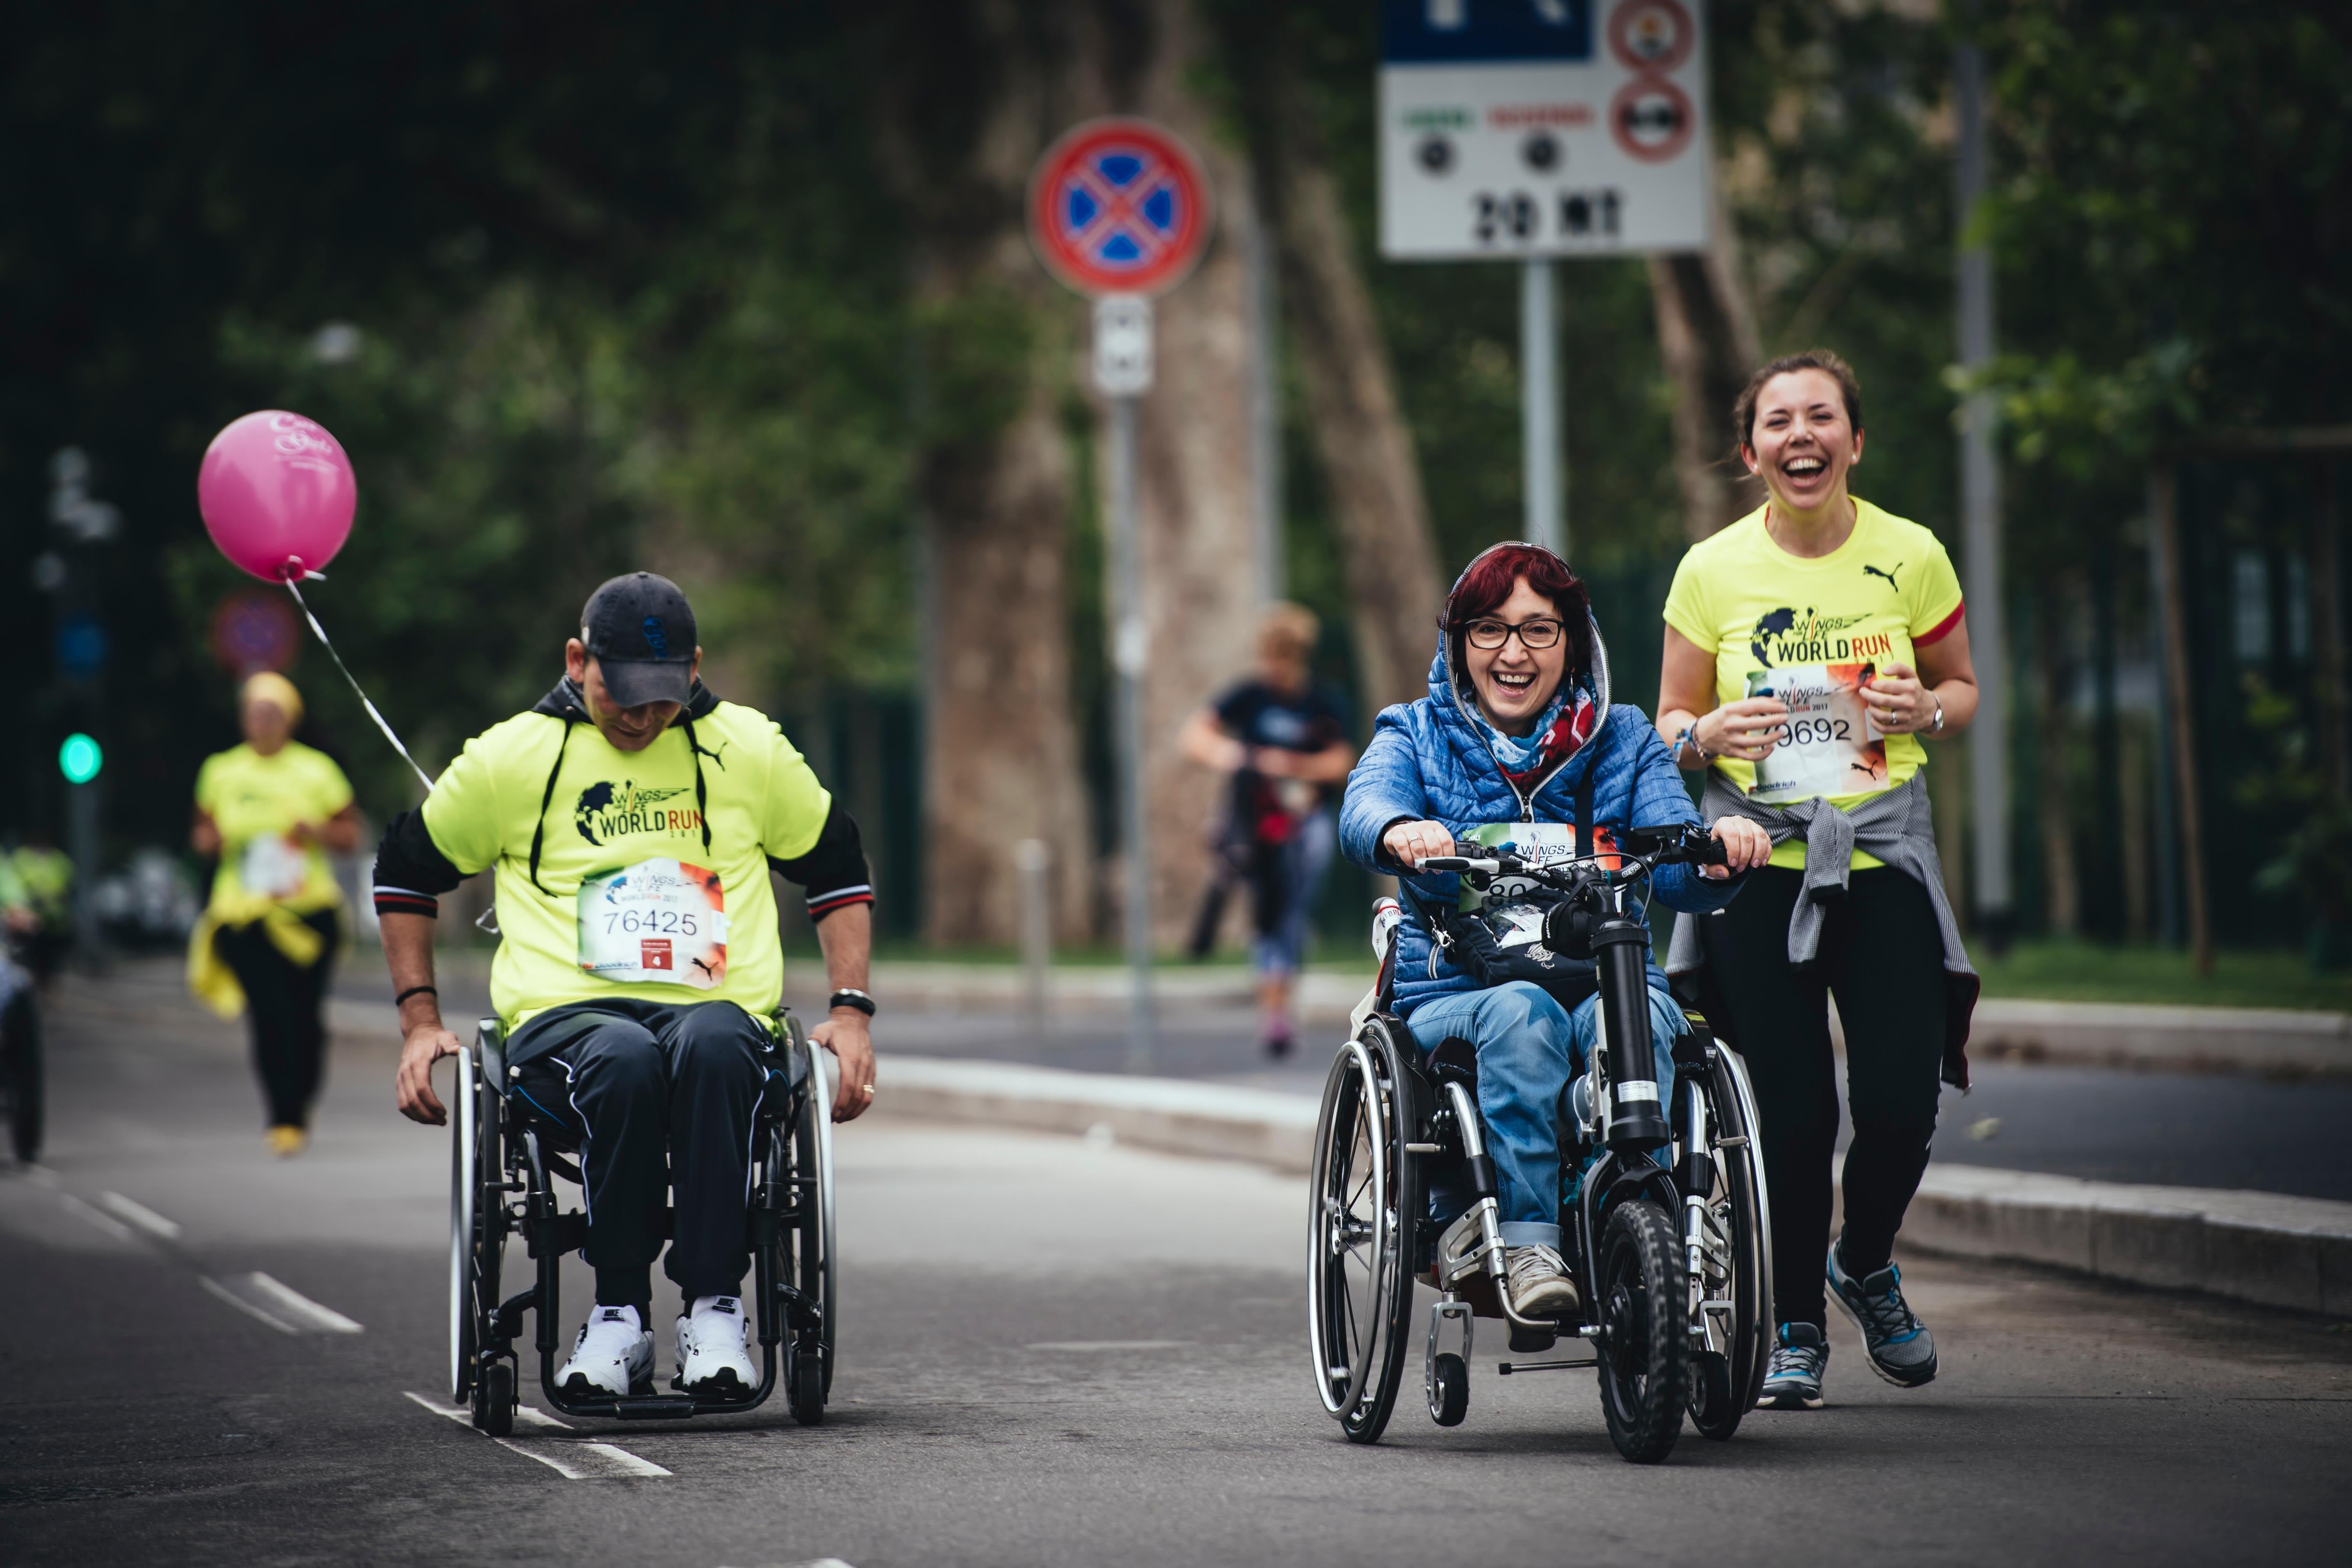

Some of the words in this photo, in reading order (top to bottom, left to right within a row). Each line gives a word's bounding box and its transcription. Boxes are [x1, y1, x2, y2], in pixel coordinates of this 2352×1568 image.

[1796, 617, 1843, 631] WINGS
[1777, 639, 1849, 662] WORLD
[1852, 633, 1891, 658] RUN
[1779, 686, 1823, 699] WINGS
[1762, 718, 1851, 749] 9692
[614, 790, 660, 803] WINGS
[600, 811, 665, 837] WORLD
[1521, 843, 1565, 855] WINGS
[1622, 863, 1641, 877] ergo
[633, 875, 675, 884] WINGS
[604, 910, 697, 936] 76425
[604, 1309, 620, 1317] NIKE
